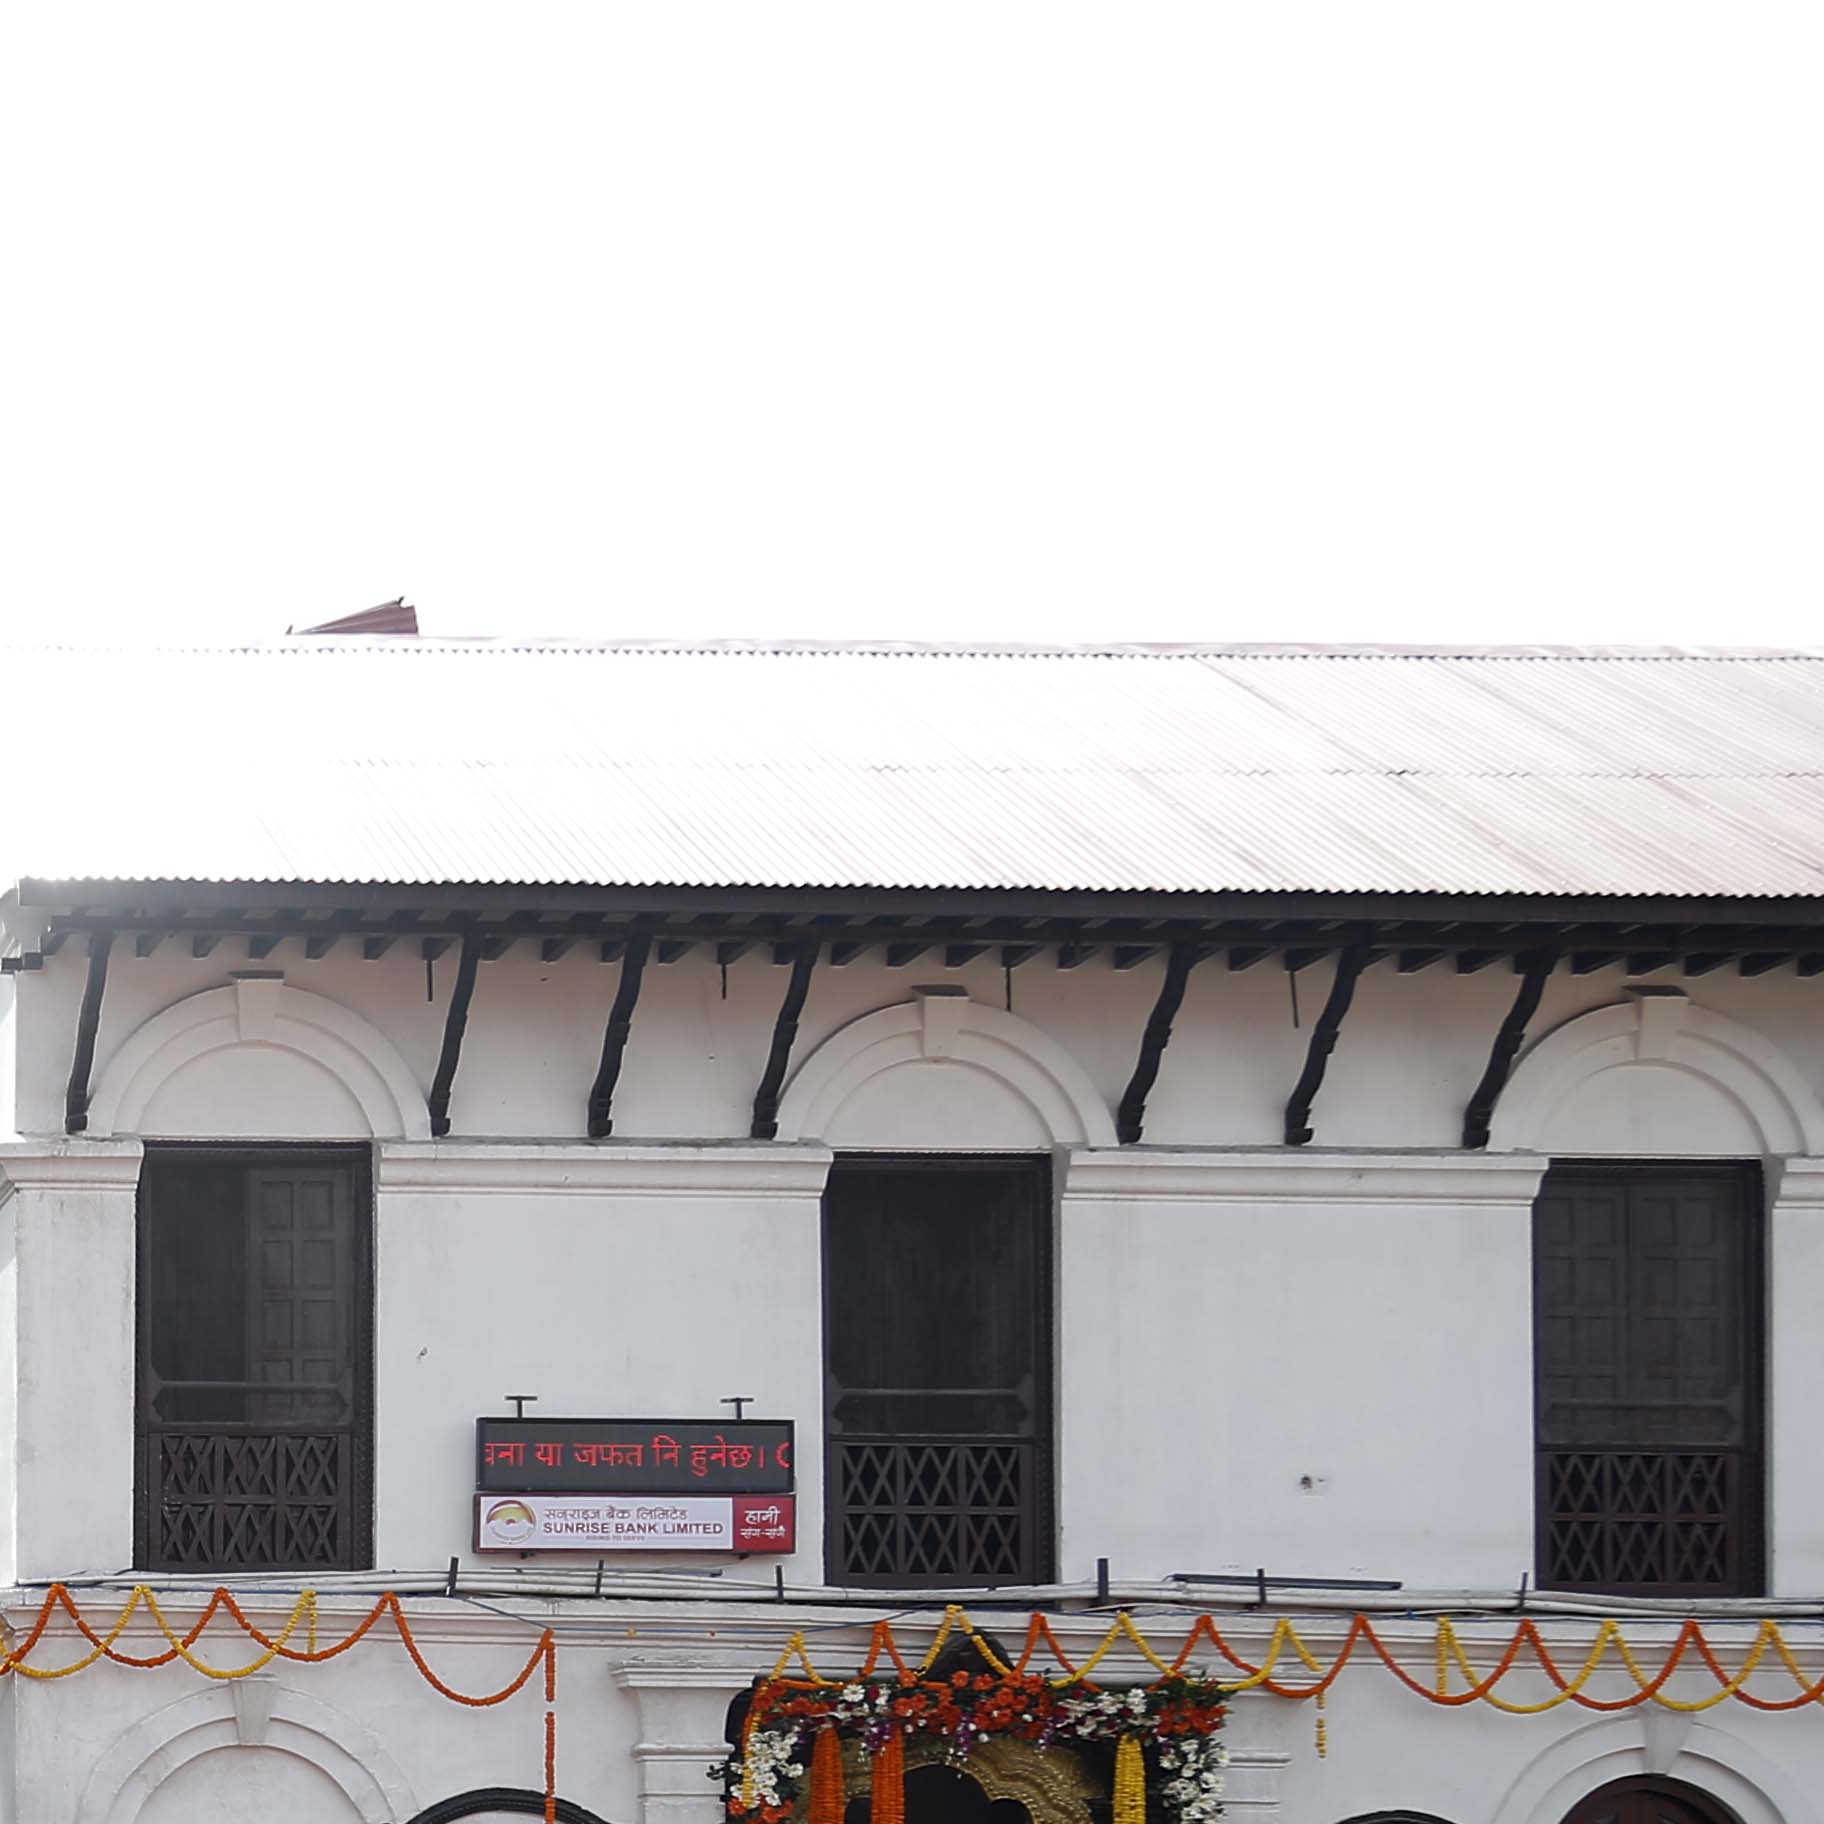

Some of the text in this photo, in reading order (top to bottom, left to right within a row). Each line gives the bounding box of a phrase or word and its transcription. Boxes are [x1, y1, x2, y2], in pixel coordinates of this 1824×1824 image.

[572, 1443, 644, 1467] जफत
[652, 1434, 681, 1468] नि
[636, 1506, 689, 1519] लिमिटेड
[743, 1505, 781, 1524] हामी
[543, 1522, 724, 1535] SUNRISE BANK LIMITED
